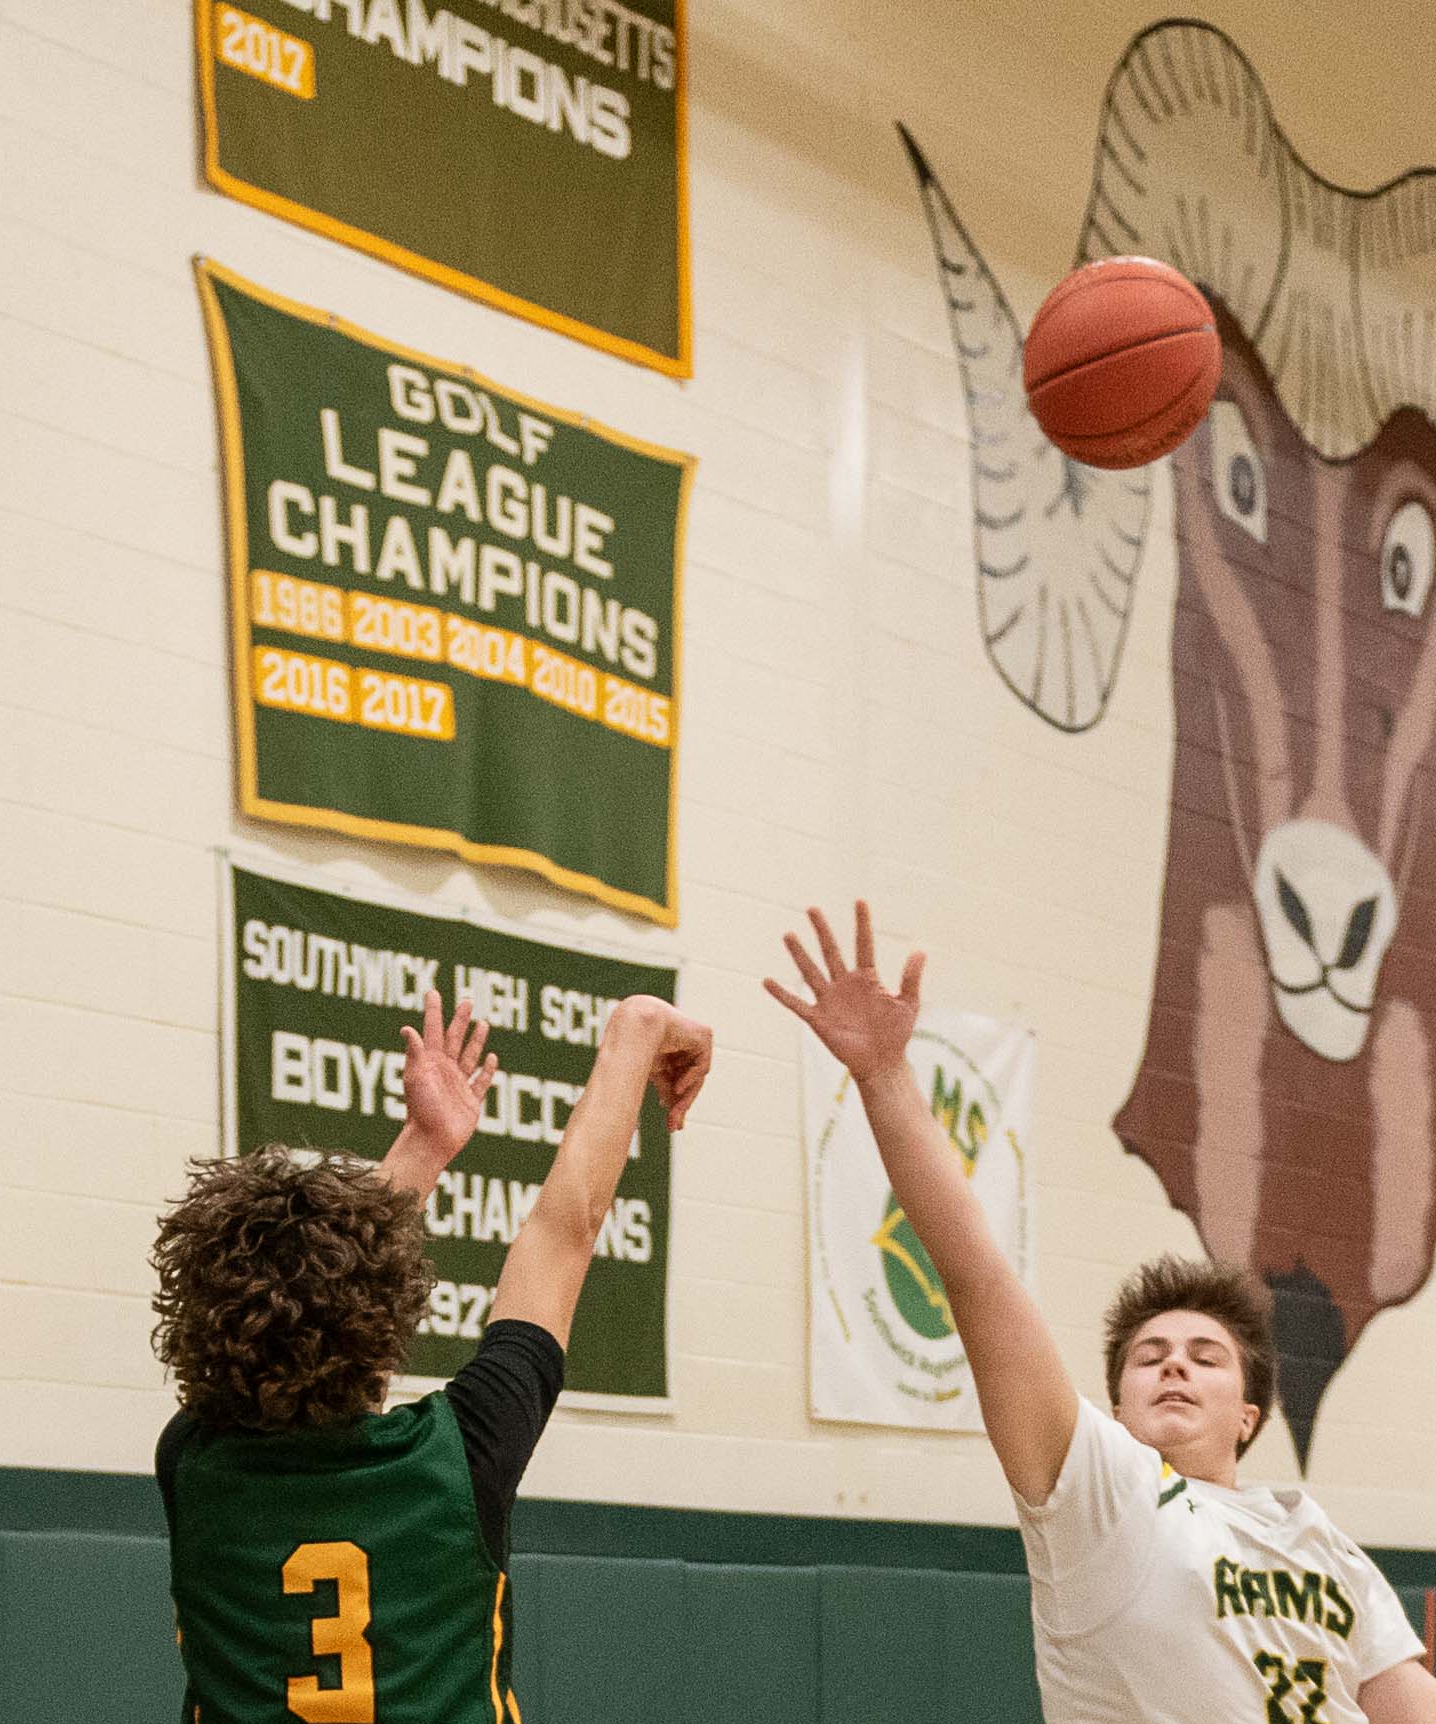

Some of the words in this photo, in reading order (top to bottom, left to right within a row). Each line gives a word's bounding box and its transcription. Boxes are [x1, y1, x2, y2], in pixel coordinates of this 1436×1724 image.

[220, 12, 305, 91] 2017
[387, 364, 555, 467] GOLF
[320, 408, 616, 580] LEAGUE
[267, 479, 659, 681] CHAMPIONS
[261, 652, 350, 714] 2016
[360, 674, 445, 733] 2017
[353, 597, 442, 656] 2003
[447, 616, 527, 684] 2004
[531, 648, 598, 714] 2010
[604, 679, 670, 741] 2015
[242, 918, 439, 1012] SOUTHWICK
[455, 963, 528, 1033] HIGH
[271, 1030, 409, 1121] BOYS
[425, 1170, 653, 1263] CHAMNS
[282, 1541, 374, 1724] 3
[1214, 1555, 1355, 1641] RAMS
